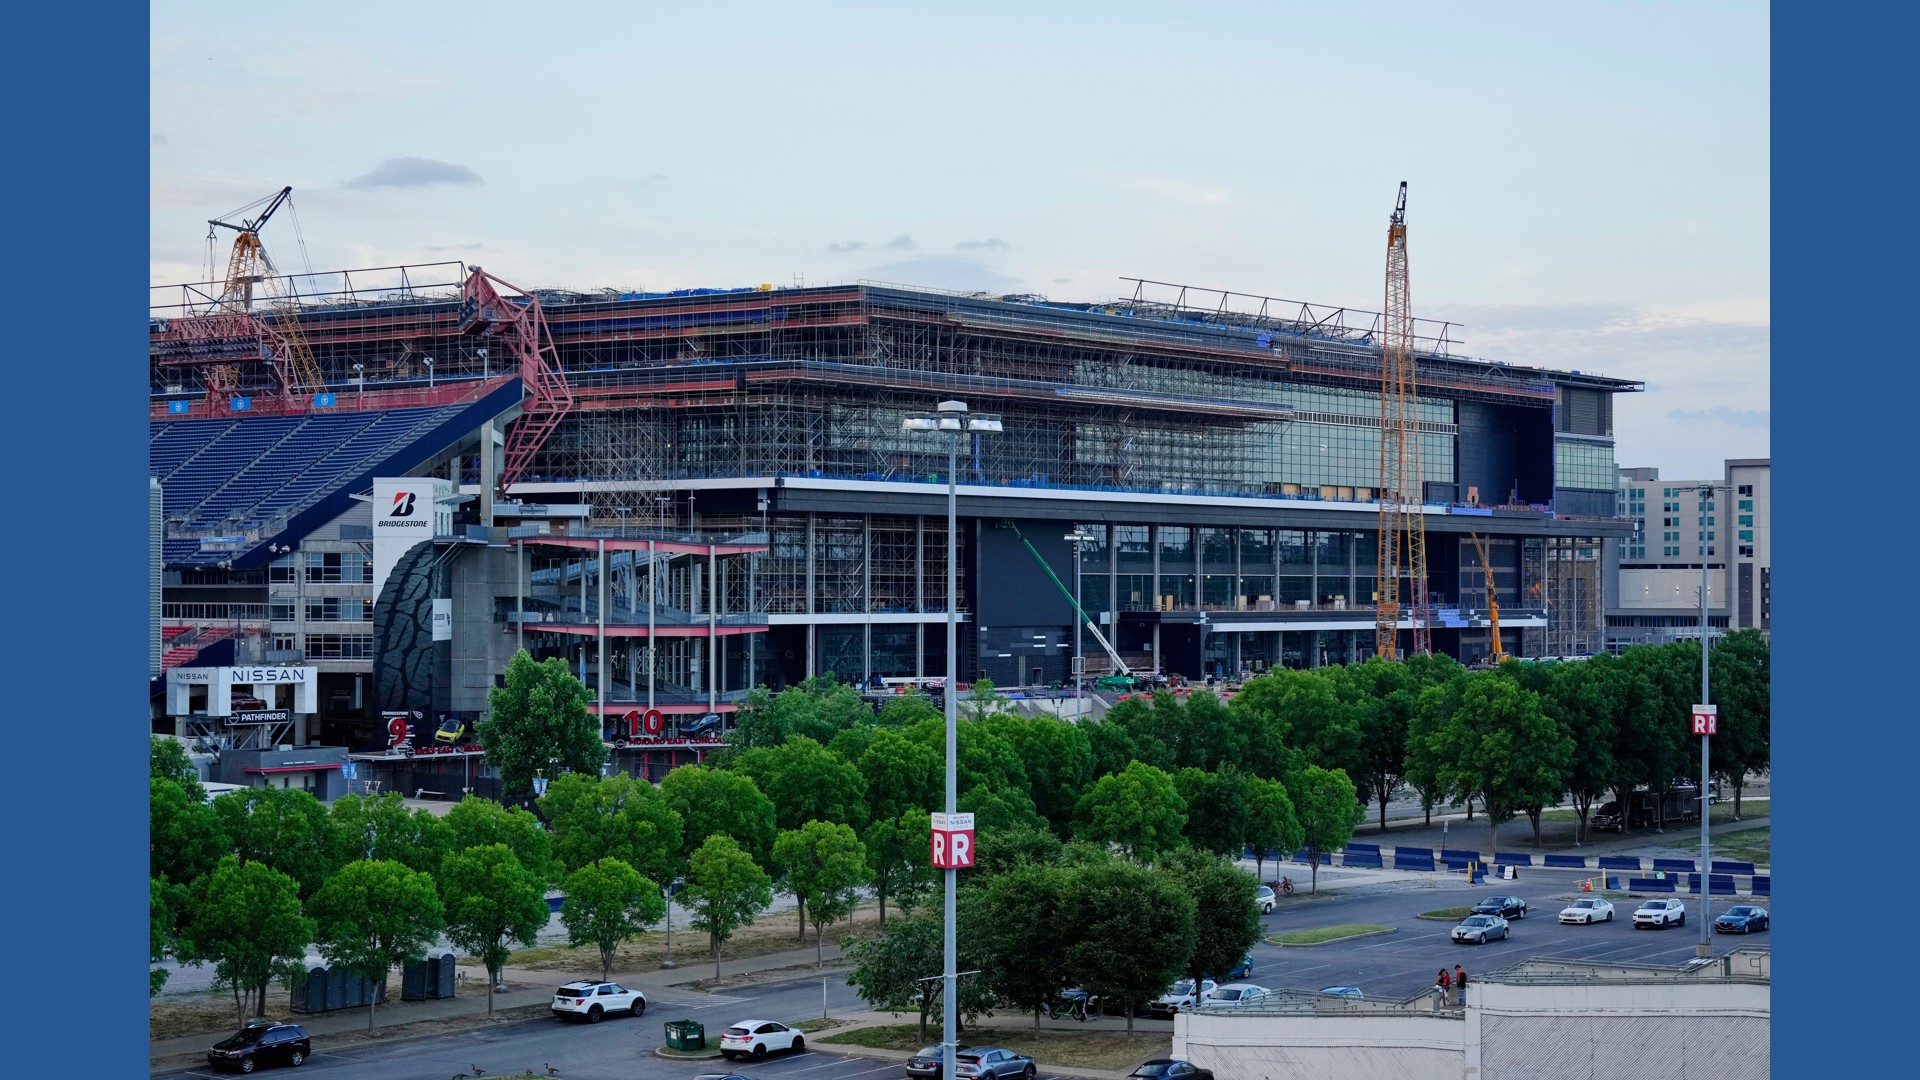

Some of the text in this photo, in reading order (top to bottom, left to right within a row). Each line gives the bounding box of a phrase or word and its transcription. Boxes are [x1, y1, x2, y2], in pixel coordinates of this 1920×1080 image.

[378, 520, 428, 528] BRIDGESTONE
[232, 669, 305, 682] NISSAN
[241, 711, 287, 722] PATHFINDER
[622, 709, 664, 735] 10
[1694, 715, 1706, 733] R
[1709, 715, 1715, 733] R
[388, 716, 407, 746] 9
[933, 832, 945, 865] R
[951, 833, 970, 866] R
